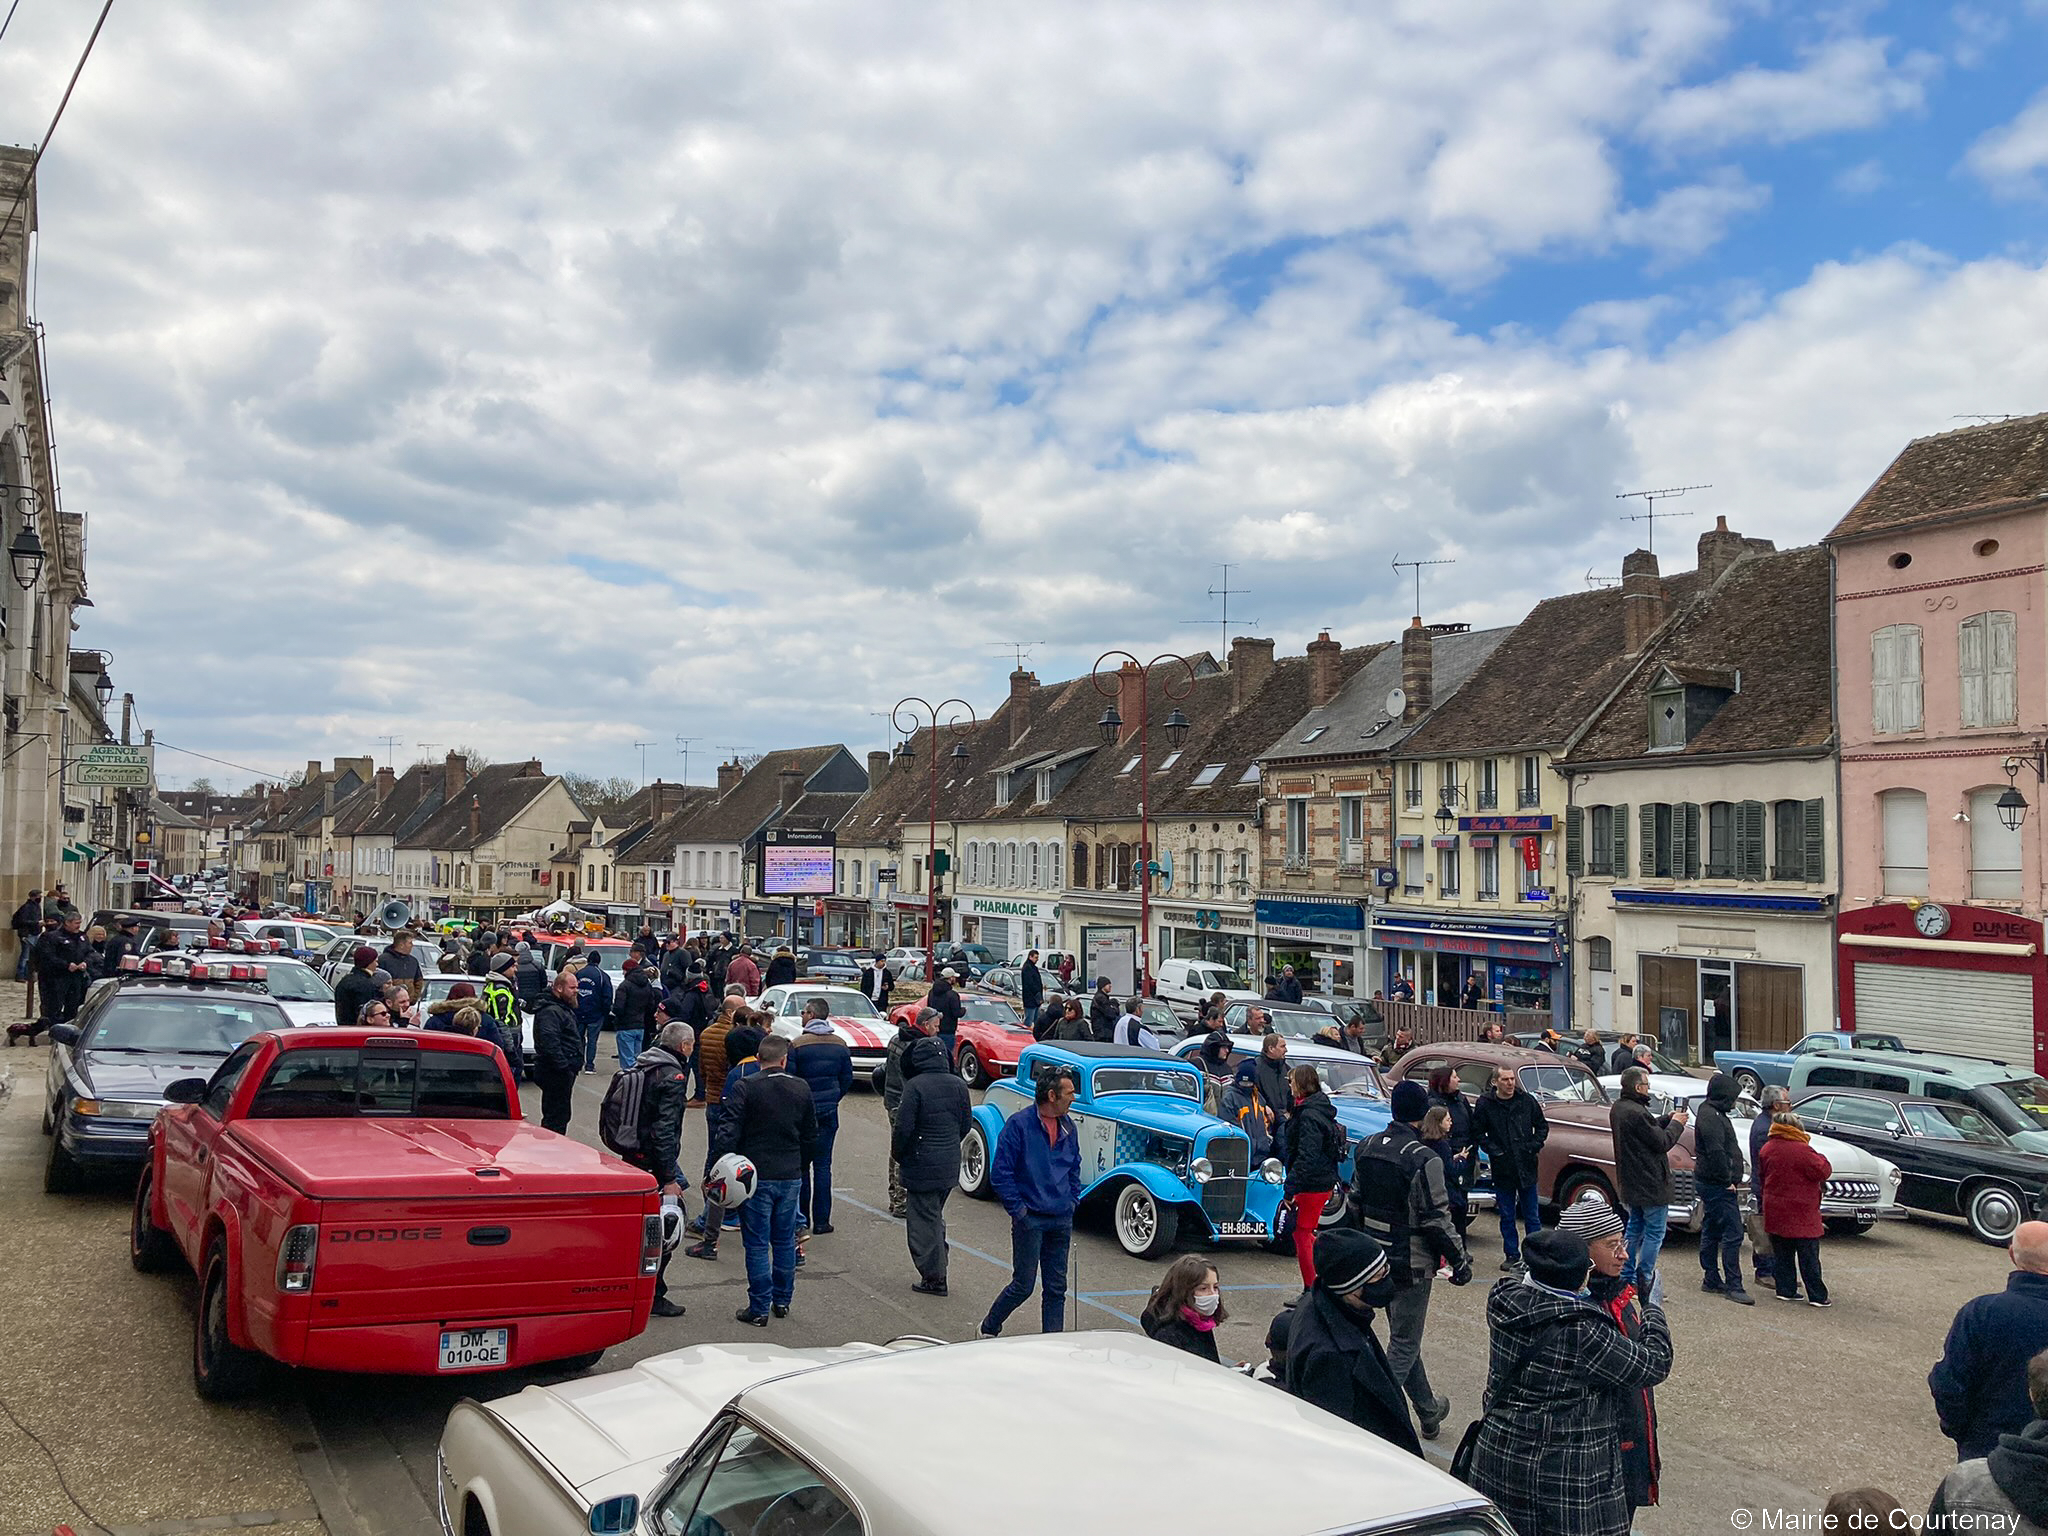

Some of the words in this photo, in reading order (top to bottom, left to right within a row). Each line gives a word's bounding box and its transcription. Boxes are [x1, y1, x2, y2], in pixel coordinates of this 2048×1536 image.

[90, 746, 138, 755] AGENCE
[80, 754, 147, 764] CENTRALE
[83, 774, 142, 783] IMMOBILIER
[1528, 838, 1537, 869] TABAC
[973, 900, 1038, 916] PHARMACIE
[1266, 925, 1310, 938] MAROQUINERIE
[1973, 922, 2031, 938] DUMEC
[1222, 1222, 1265, 1234] EH-886-JC
[330, 1227, 443, 1244] DODGE
[571, 1285, 630, 1295] DAKOTA
[460, 1333, 489, 1348] DM-
[447, 1347, 499, 1364] 010-QE
